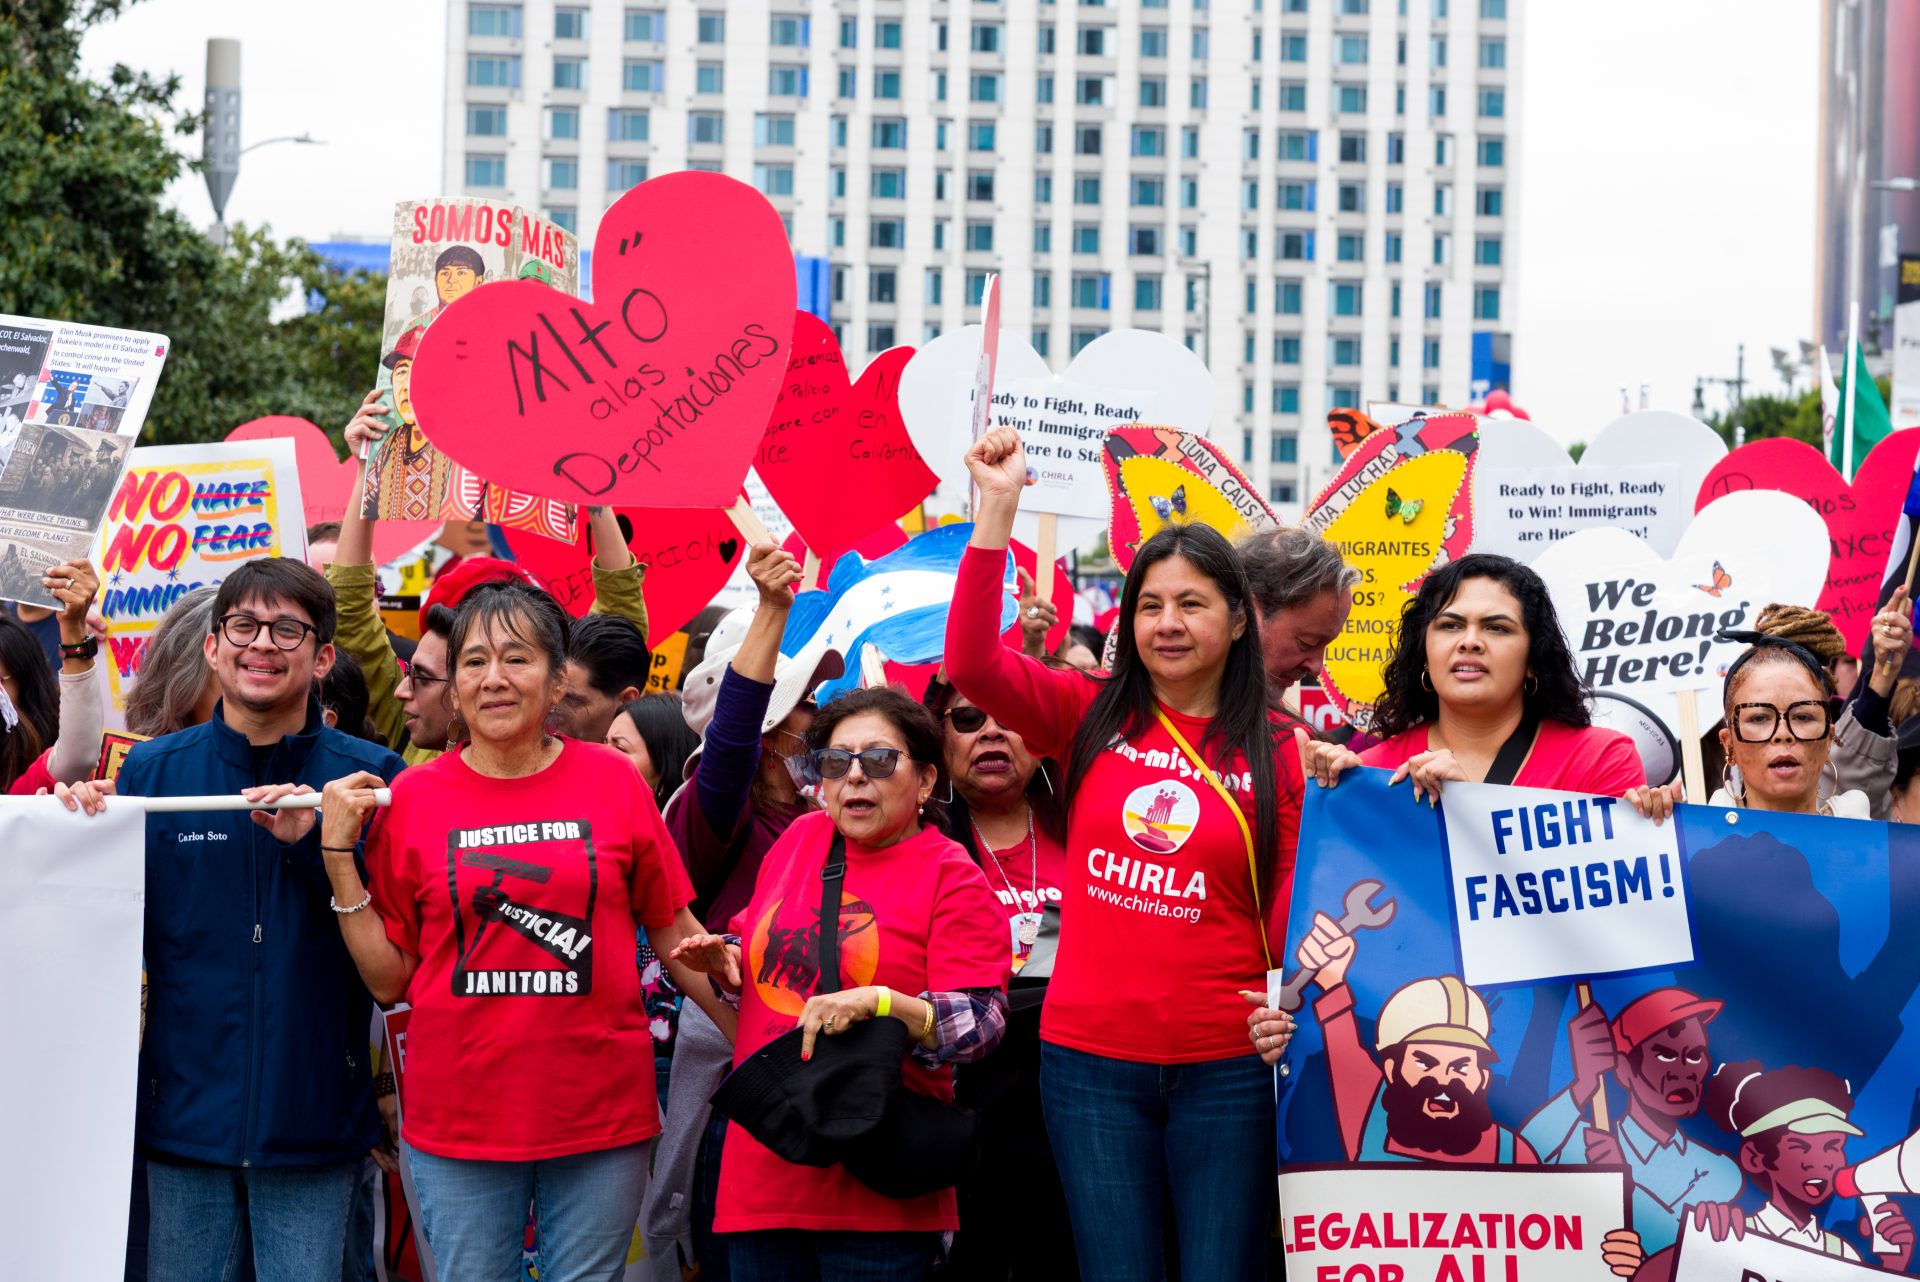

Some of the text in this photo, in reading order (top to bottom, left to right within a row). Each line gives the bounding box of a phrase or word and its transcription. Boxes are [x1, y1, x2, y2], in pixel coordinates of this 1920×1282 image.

[412, 203, 565, 270] SOMOS MÁS
[60, 327, 151, 346] Elon Musk promises to apply
[84, 340, 103, 349] model
[112, 343, 119, 351] El
[120, 344, 149, 355] Salvador
[60, 351, 84, 360] control
[84, 353, 102, 361] crime
[111, 355, 123, 363] the
[123, 356, 145, 367] United
[81, 362, 93, 370] will
[553, 323, 779, 496] Deportaciones
[1023, 395, 1039, 408] to
[1044, 396, 1088, 416] Fight,
[1094, 403, 1142, 422] Ready
[1057, 446, 1072, 459] to
[1041, 470, 1074, 482] CHIRLA
[1340, 448, 1397, 501] LUCHA!
[107, 470, 272, 523] NO HATE
[1499, 481, 1666, 499] Ready to Fight, Ready
[0, 508, 16, 517] HAT
[16, 511, 35, 521] WERE
[36, 514, 55, 523] ONCE
[1508, 504, 1658, 520] to Win! Immigrants
[14, 528, 42, 539] BECOME
[42, 532, 70, 543] PLANES
[102, 521, 275, 573] NO FEAR
[1517, 530, 1543, 541] are
[20, 547, 29, 557] EL
[1584, 578, 1657, 613] We
[1579, 601, 1751, 652] Belong
[1583, 640, 1711, 688] Here!
[178, 831, 228, 843] Carlos Soto
[458, 821, 581, 849] JUSTICE FOR
[1490, 797, 1617, 855] FIGHT
[1087, 847, 1207, 900] CHIRLA
[1465, 853, 1675, 921] FASCISM!
[1086, 883, 1202, 924] www.chirla.org
[498, 902, 593, 961] JUSTICIA!
[465, 970, 579, 994] JANITORS
[1282, 1212, 1584, 1254] LEGALIZATION
